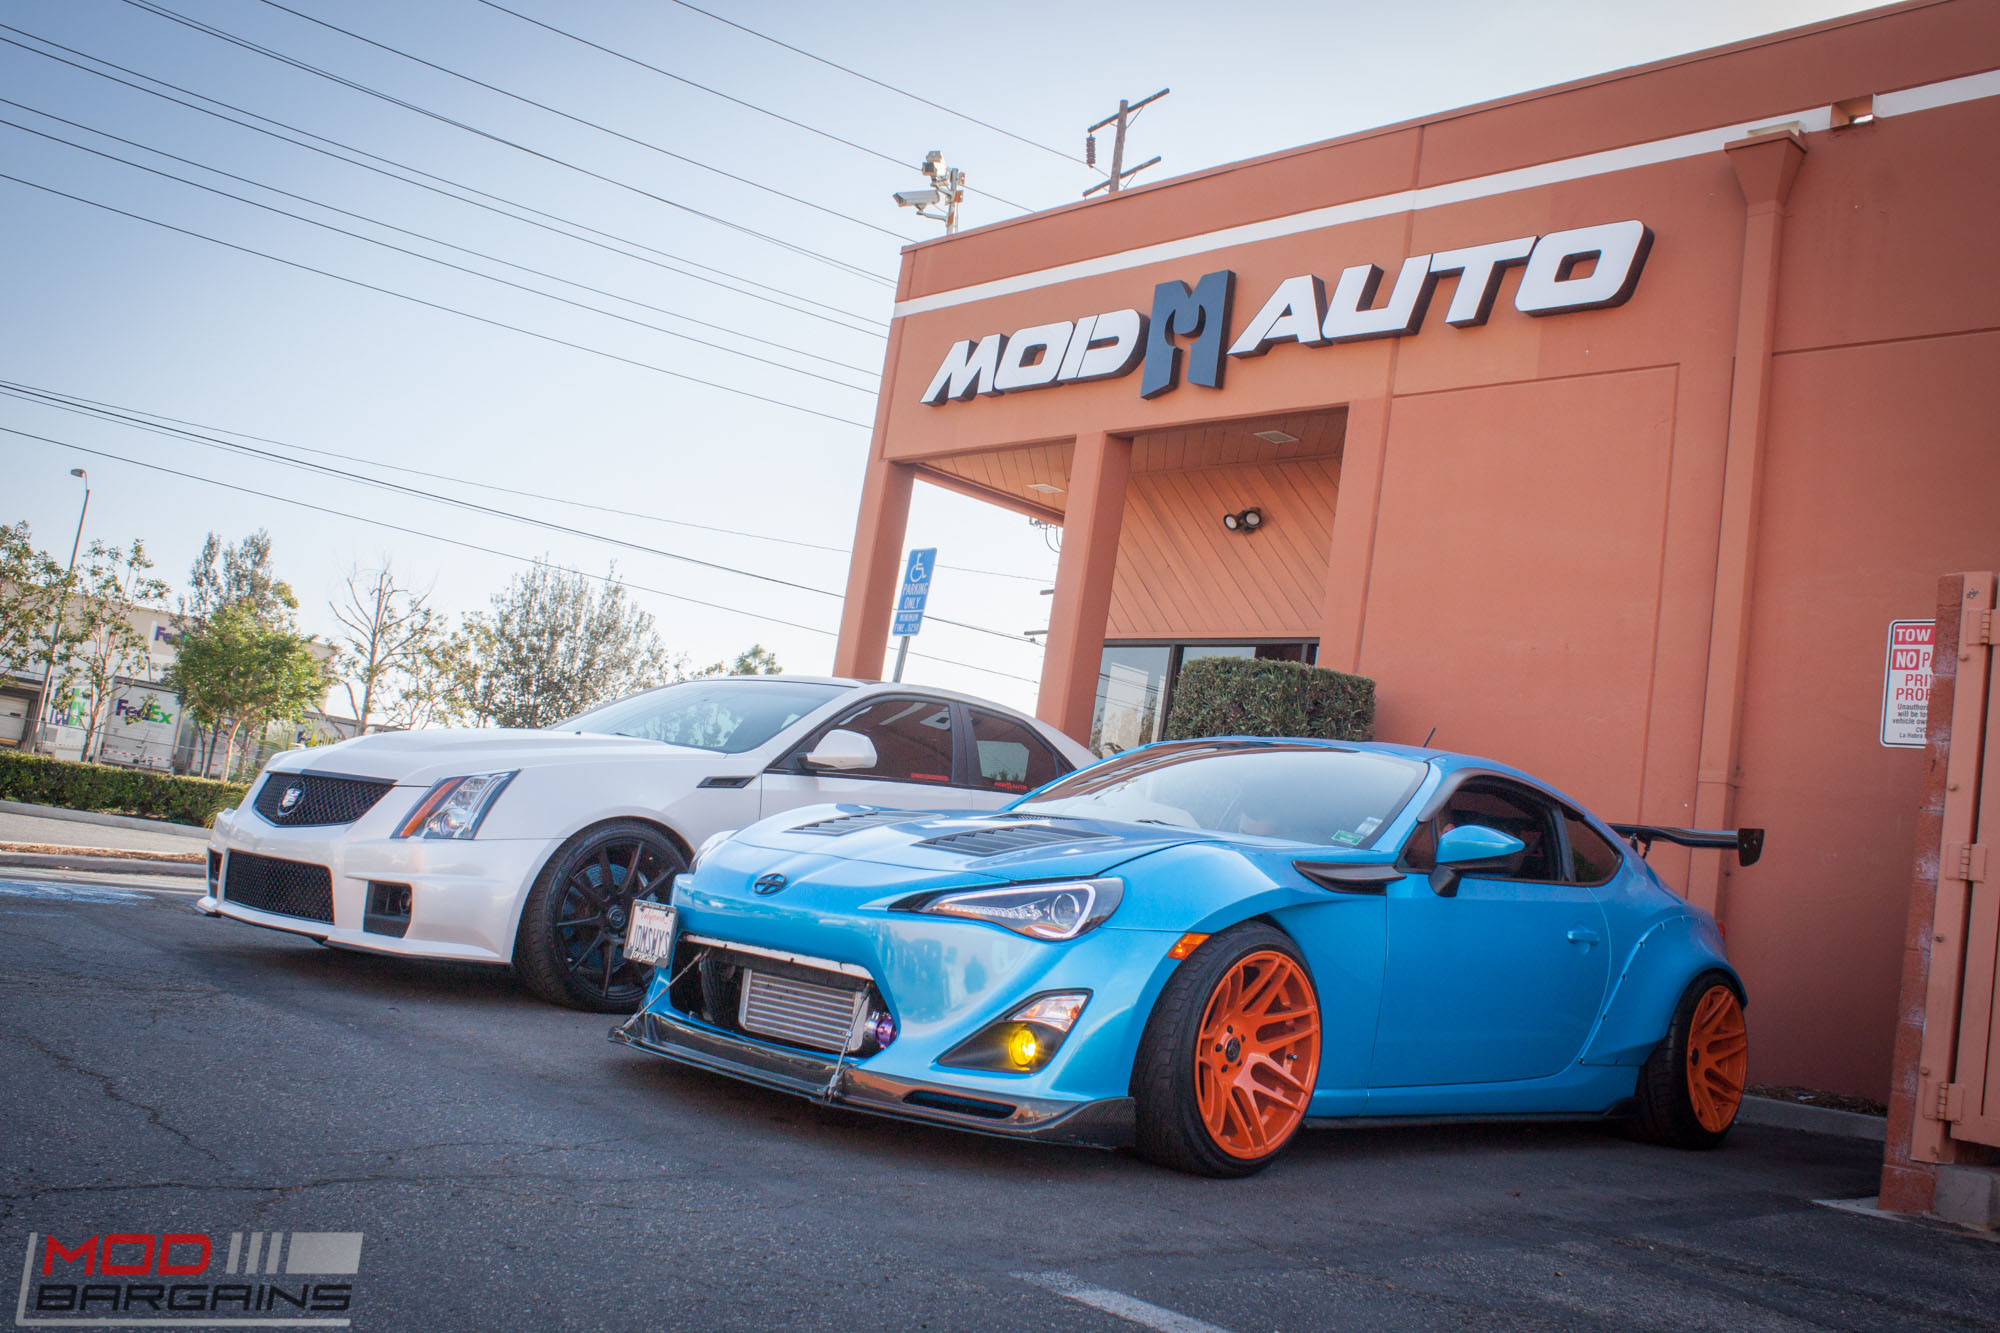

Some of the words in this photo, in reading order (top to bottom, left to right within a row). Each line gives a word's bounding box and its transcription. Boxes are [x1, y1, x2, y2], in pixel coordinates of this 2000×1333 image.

[920, 308, 1147, 405] MOD
[1227, 219, 1654, 358] AUTO
[903, 583, 928, 595] PARKING
[904, 597, 921, 609] ONLY
[1896, 628, 1932, 642] TOW
[1896, 651, 1917, 668] NO
[1904, 673, 1933, 687] PRI
[1892, 717, 1915, 725] vehicle
